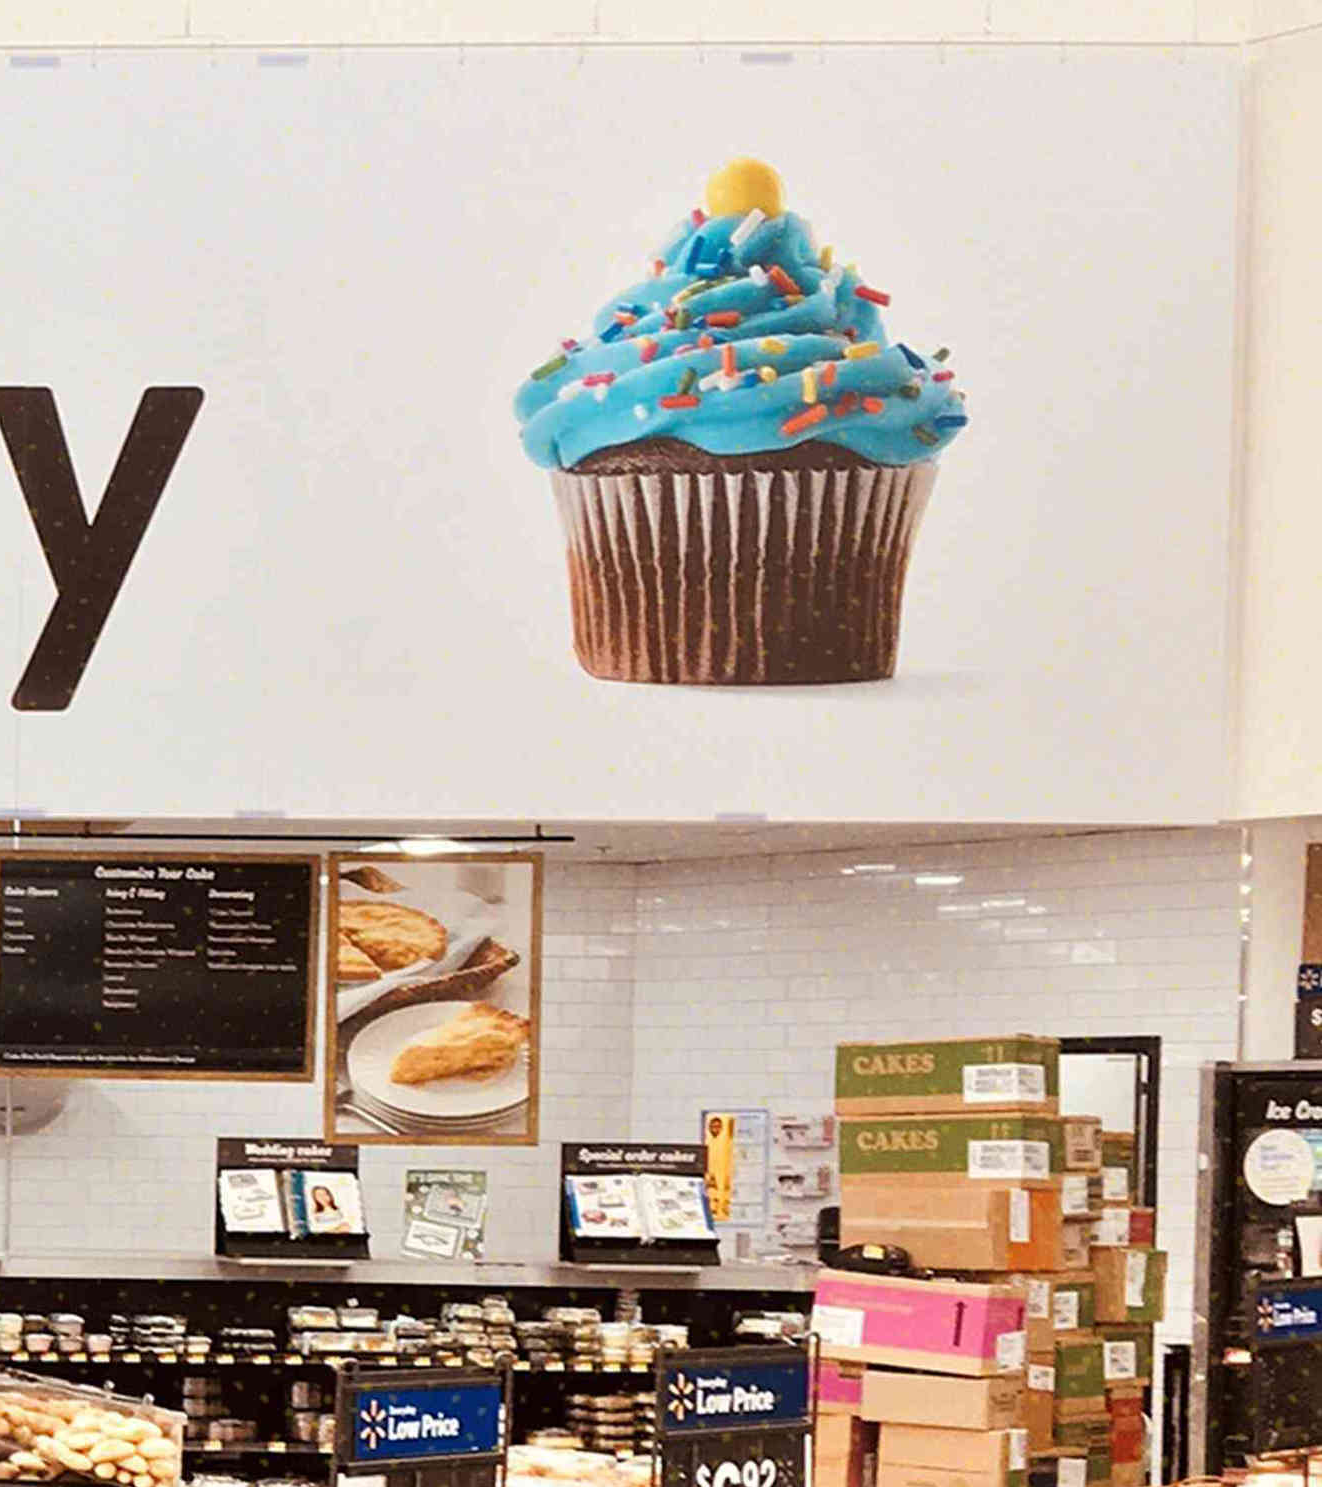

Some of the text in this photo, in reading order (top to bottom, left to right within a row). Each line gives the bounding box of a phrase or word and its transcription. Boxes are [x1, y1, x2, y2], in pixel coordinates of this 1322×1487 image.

[852, 1052, 936, 1077] CAKES
[856, 1128, 940, 1152] CAKES
[577, 1147, 624, 1165] Special
[695, 1384, 775, 1416] Low Price
[387, 1411, 461, 1441] Low Price
